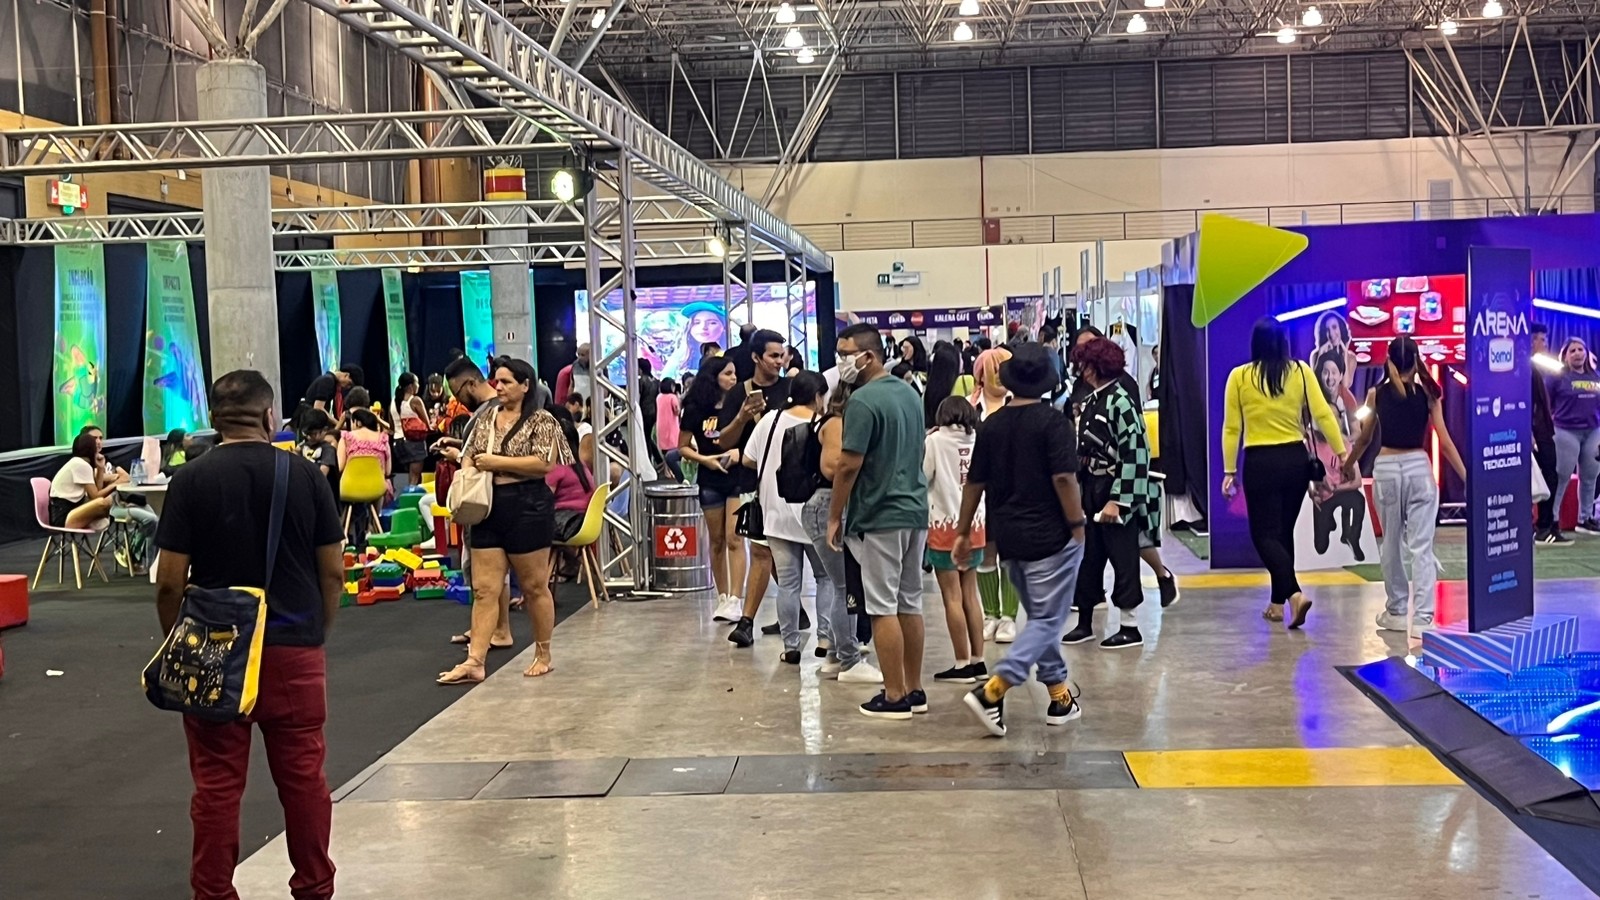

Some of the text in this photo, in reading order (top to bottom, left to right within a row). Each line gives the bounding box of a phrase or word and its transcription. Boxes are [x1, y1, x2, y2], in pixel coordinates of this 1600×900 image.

[1473, 309, 1529, 336] ARENA
[1494, 443, 1516, 456] GAMES
[1483, 456, 1521, 470] TECNOLOGIA
